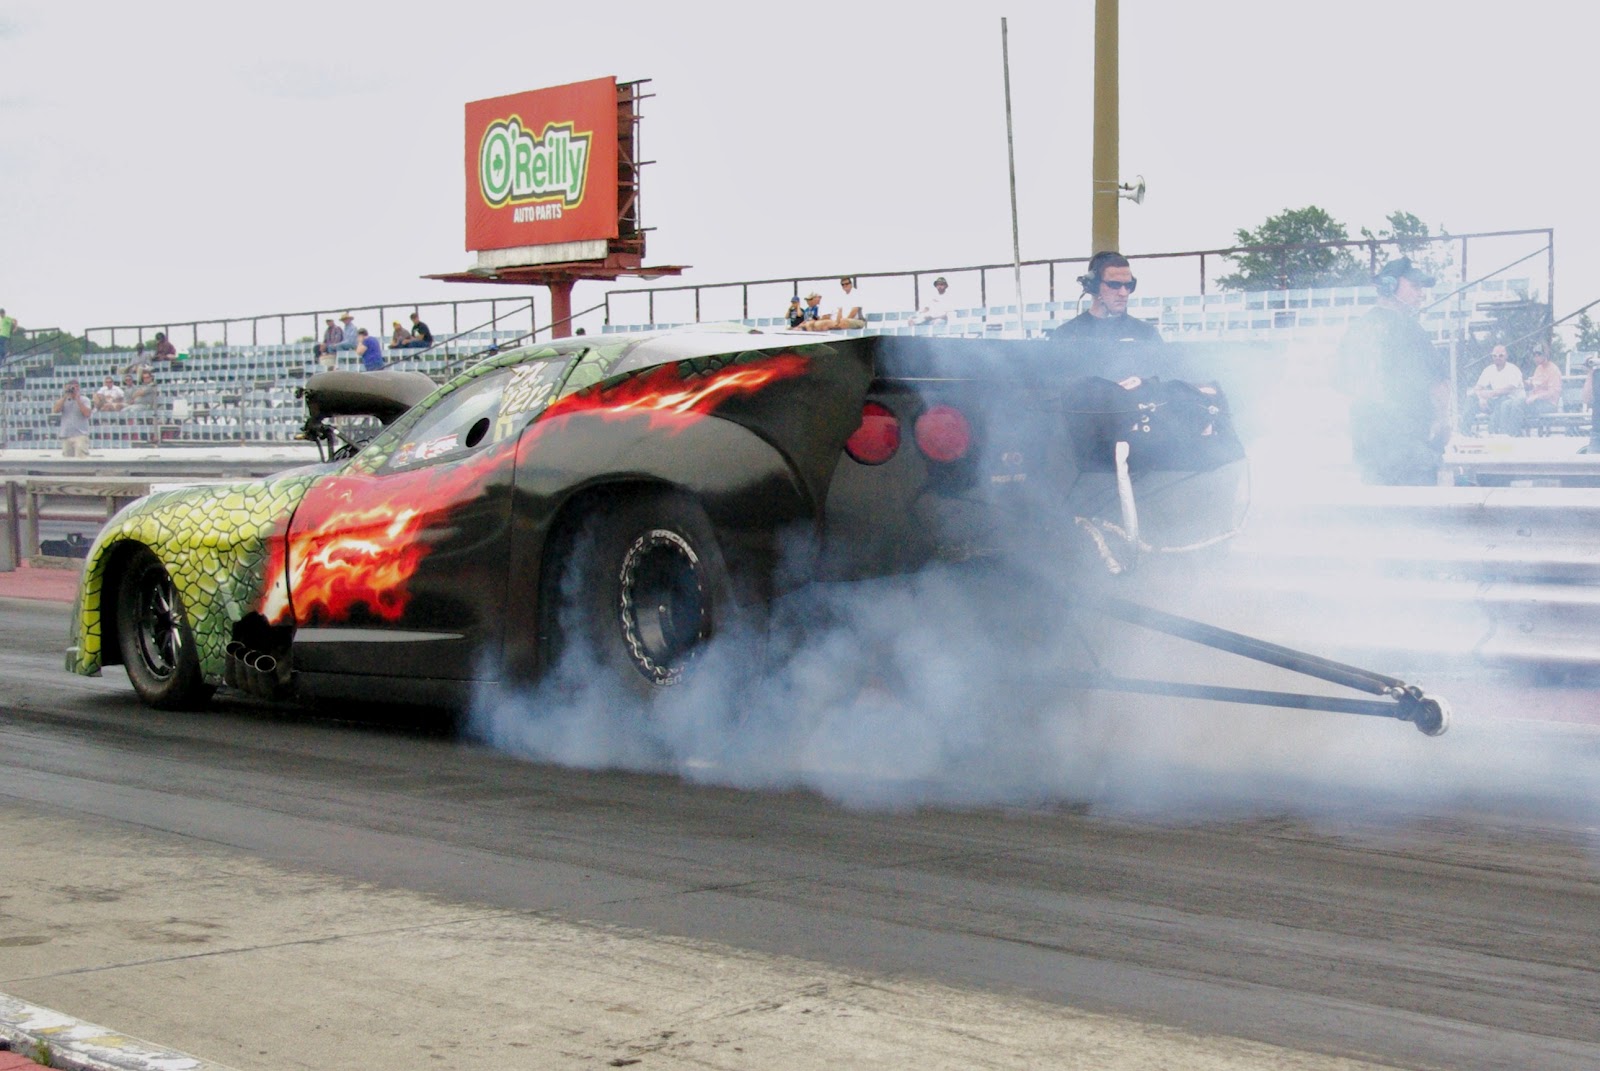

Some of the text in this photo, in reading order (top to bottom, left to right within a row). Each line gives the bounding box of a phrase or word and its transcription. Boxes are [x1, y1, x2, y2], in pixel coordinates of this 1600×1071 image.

[483, 125, 585, 197] O'Reilly
[513, 204, 562, 223] AUTO PARTS
[651, 529, 699, 563] RACING
[656, 675, 682, 686] USA
